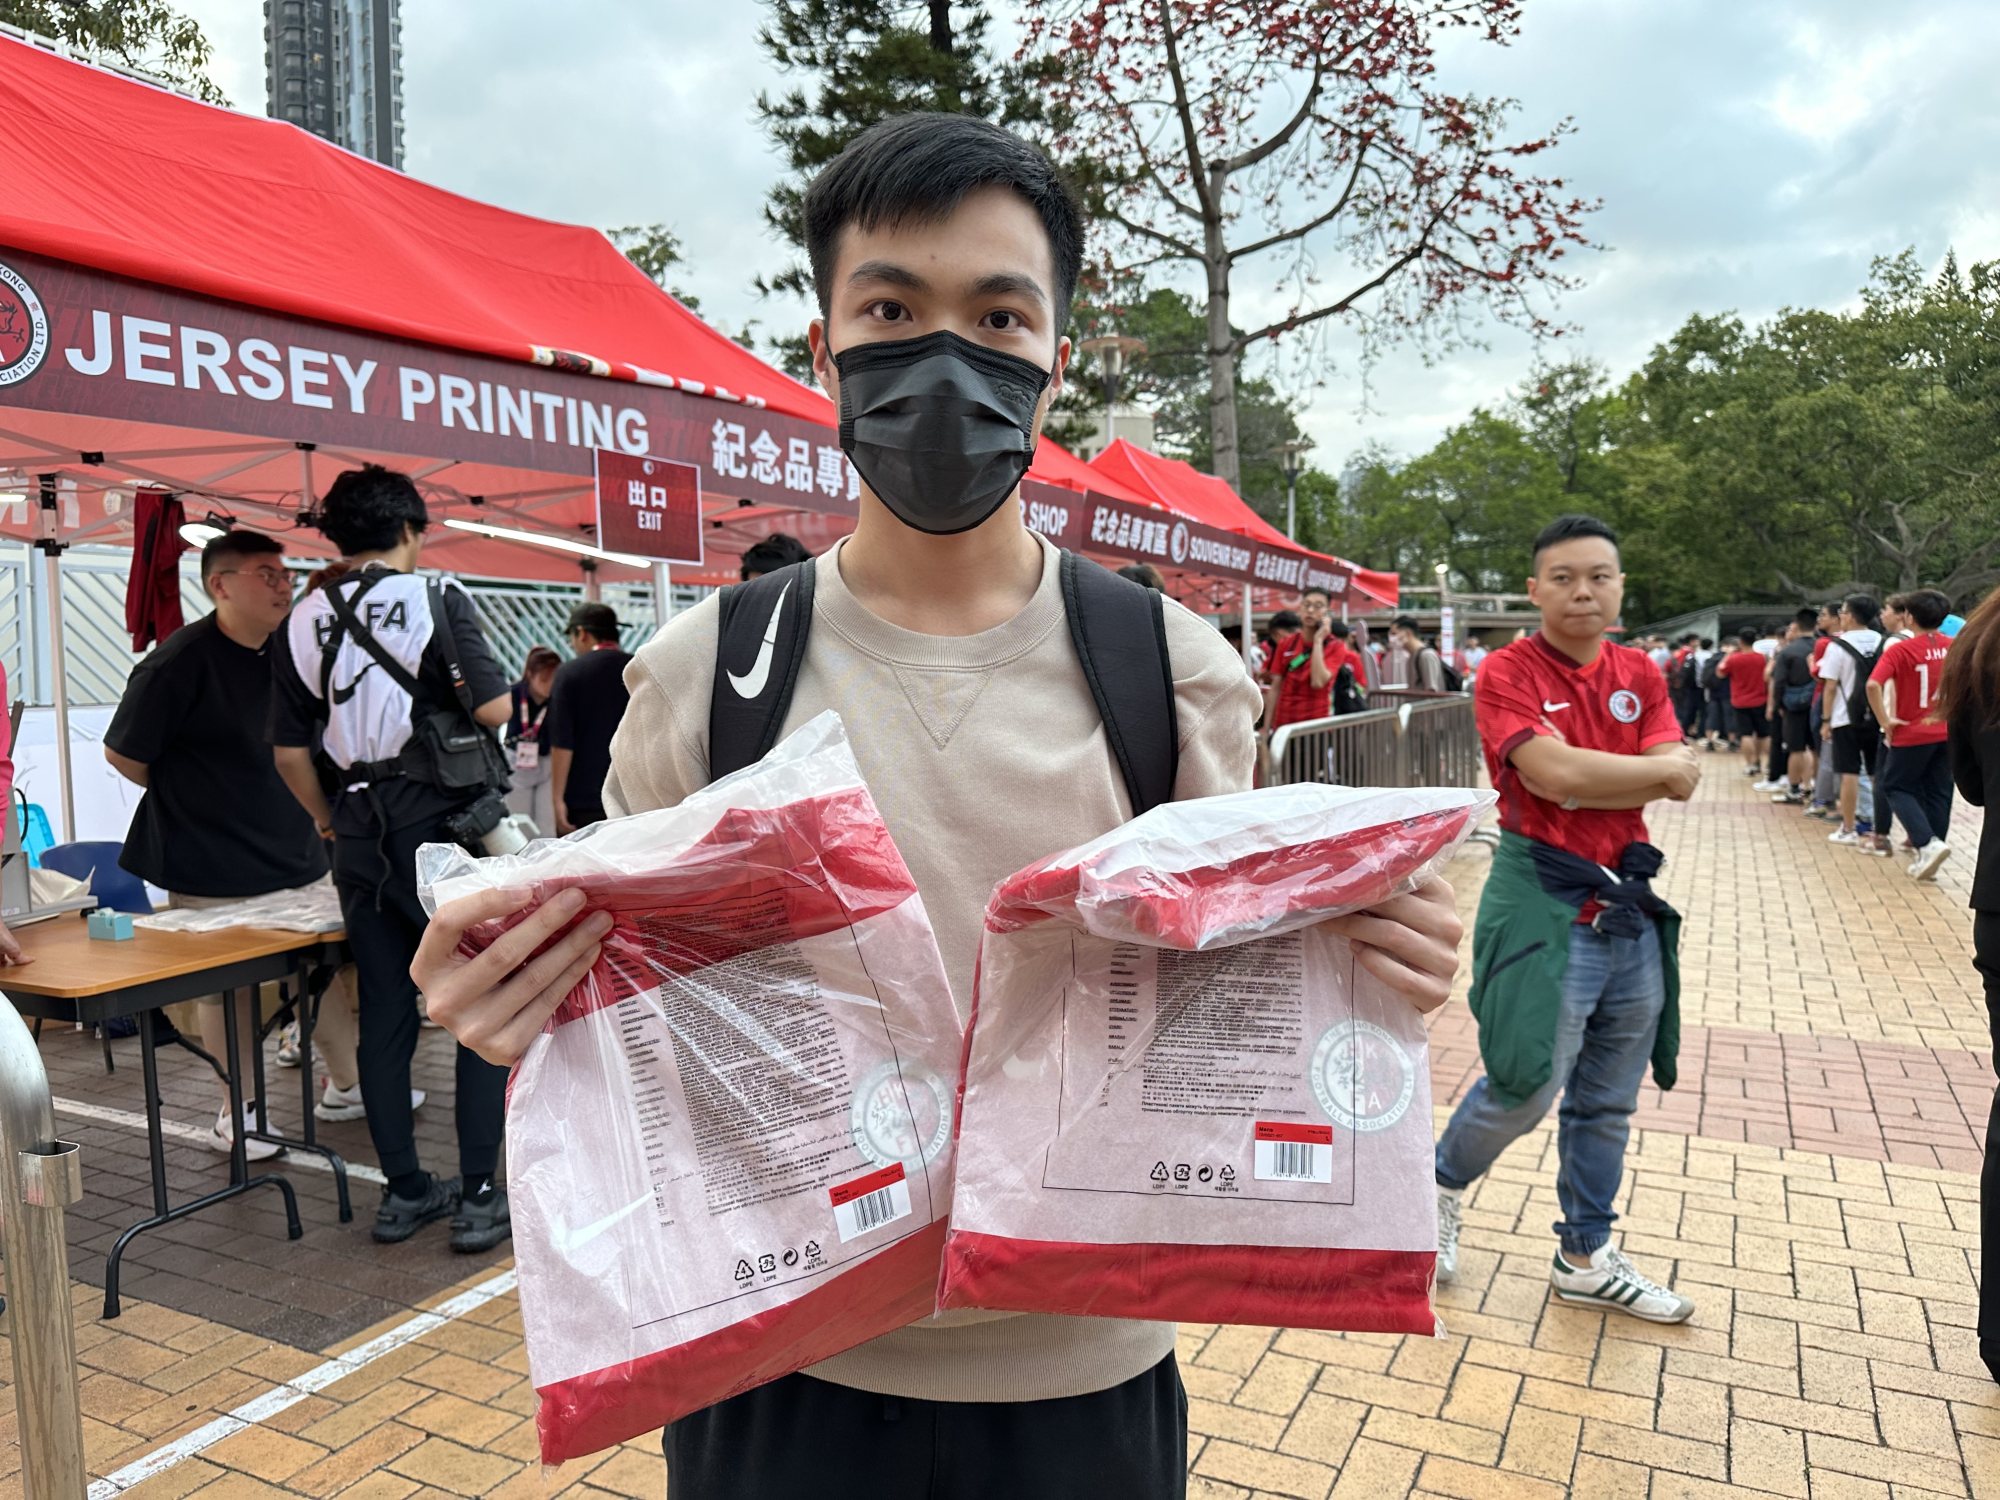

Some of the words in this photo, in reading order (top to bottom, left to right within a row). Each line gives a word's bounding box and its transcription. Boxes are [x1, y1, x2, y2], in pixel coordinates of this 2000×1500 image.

[64, 309, 378, 413] JERSEY
[401, 367, 649, 456] PRINTING
[628, 480, 667, 509] 出口
[637, 510, 662, 531] EXIT
[1029, 501, 1068, 536] SHOP
[313, 599, 410, 648] HFA
